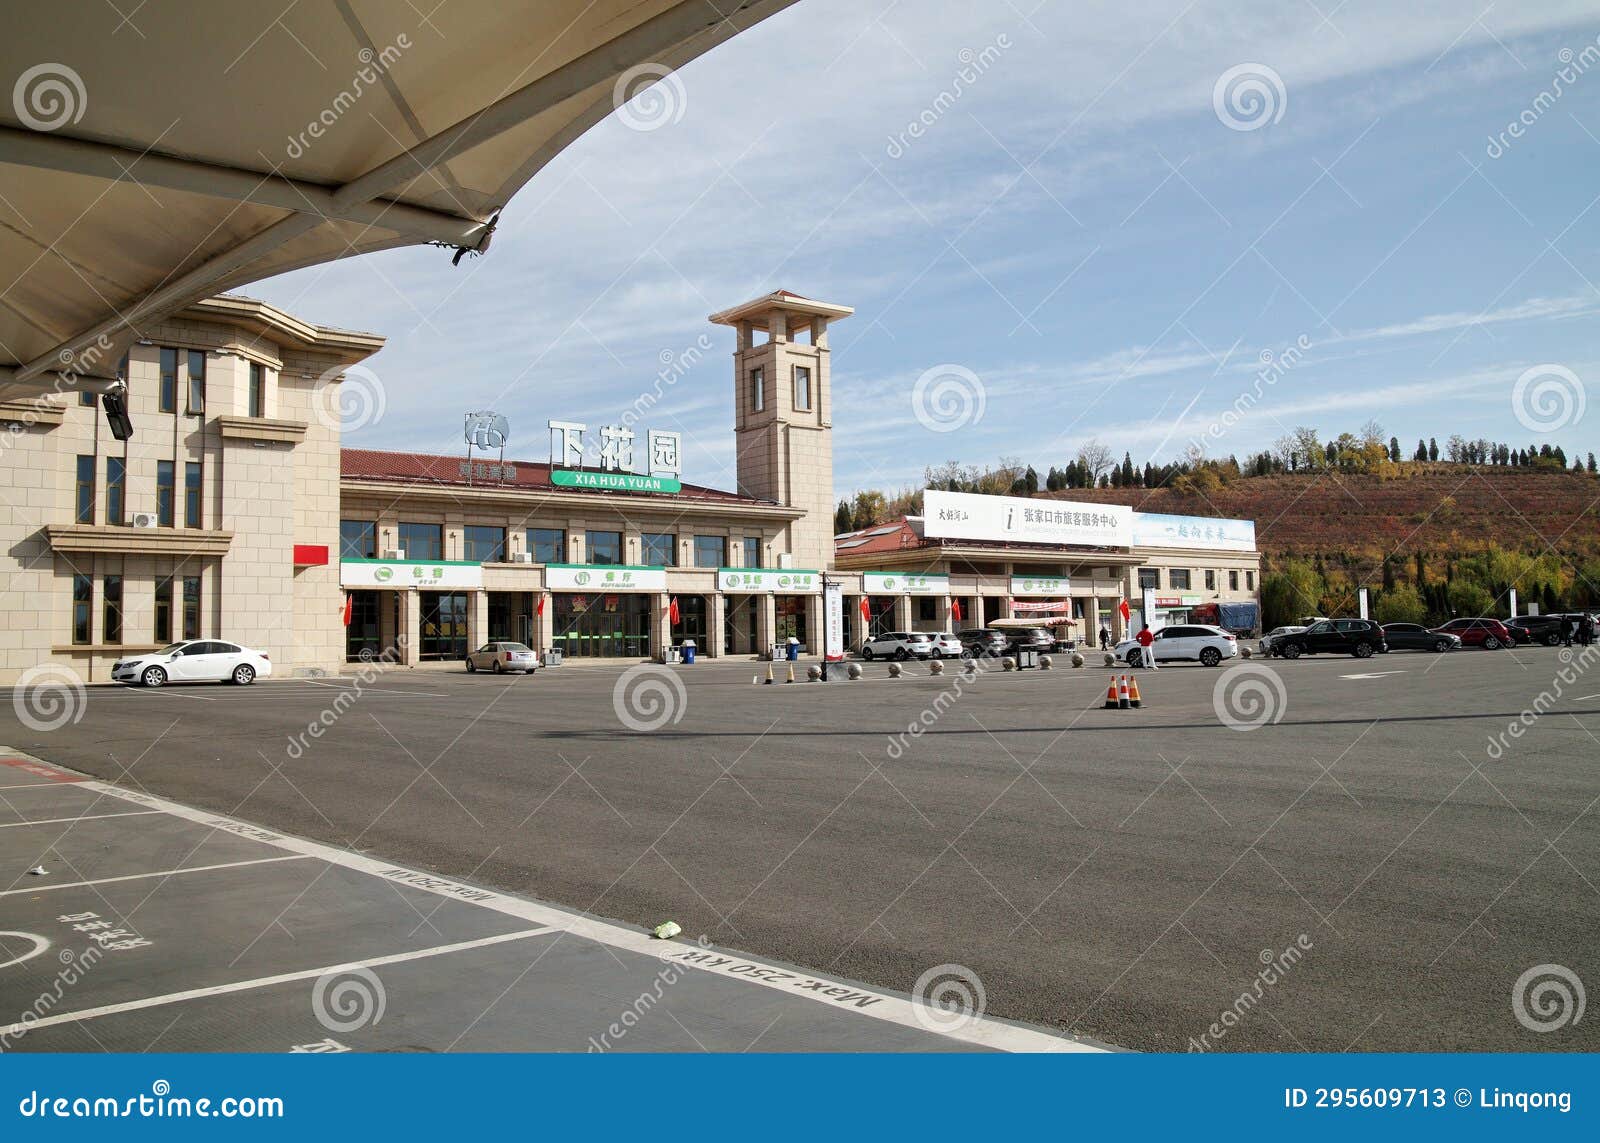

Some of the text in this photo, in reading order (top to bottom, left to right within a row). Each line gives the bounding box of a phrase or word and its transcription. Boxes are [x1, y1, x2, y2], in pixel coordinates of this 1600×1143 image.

[548, 419, 681, 474] 下花园
[575, 474, 661, 489] XIA HUA YUAN
[939, 508, 969, 521] 大好河山
[1024, 508, 1118, 528] 张家口市旅客服务中心
[727, 964, 796, 984] 250
[793, 980, 883, 1009] Max:
